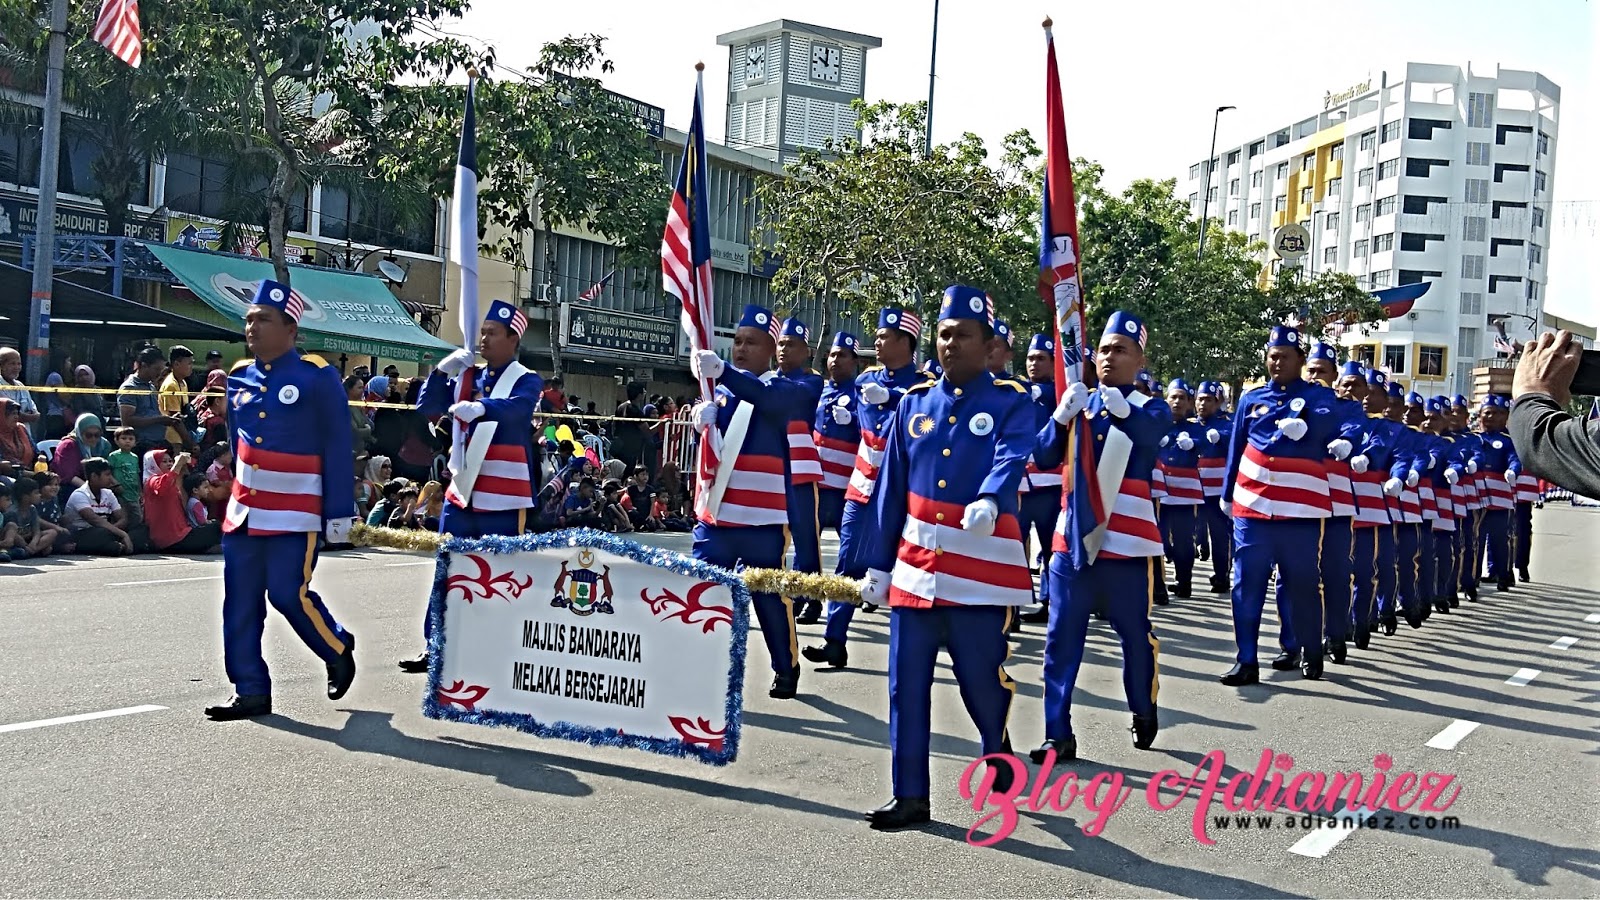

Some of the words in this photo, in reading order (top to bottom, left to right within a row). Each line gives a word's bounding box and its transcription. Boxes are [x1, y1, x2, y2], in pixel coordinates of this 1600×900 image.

[55, 212, 96, 233] BAIDURI
[318, 300, 373, 313] ENERGY
[374, 304, 395, 315] TO
[335, 312, 358, 321] GO
[600, 327, 614, 337] AUTO
[615, 328, 620, 337] &
[620, 328, 649, 342] MACHINERY
[649, 333, 660, 343] SDN
[660, 334, 671, 345] BHD
[323, 338, 361, 353] RESTORAN
[361, 342, 380, 356] MAJU
[380, 345, 420, 361] ENTERPRISE
[522, 619, 566, 654] MAJLIS
[568, 625, 642, 664] BANDARAYA
[512, 661, 562, 697] MELAKA
[564, 669, 646, 709] BERSEJARAH
